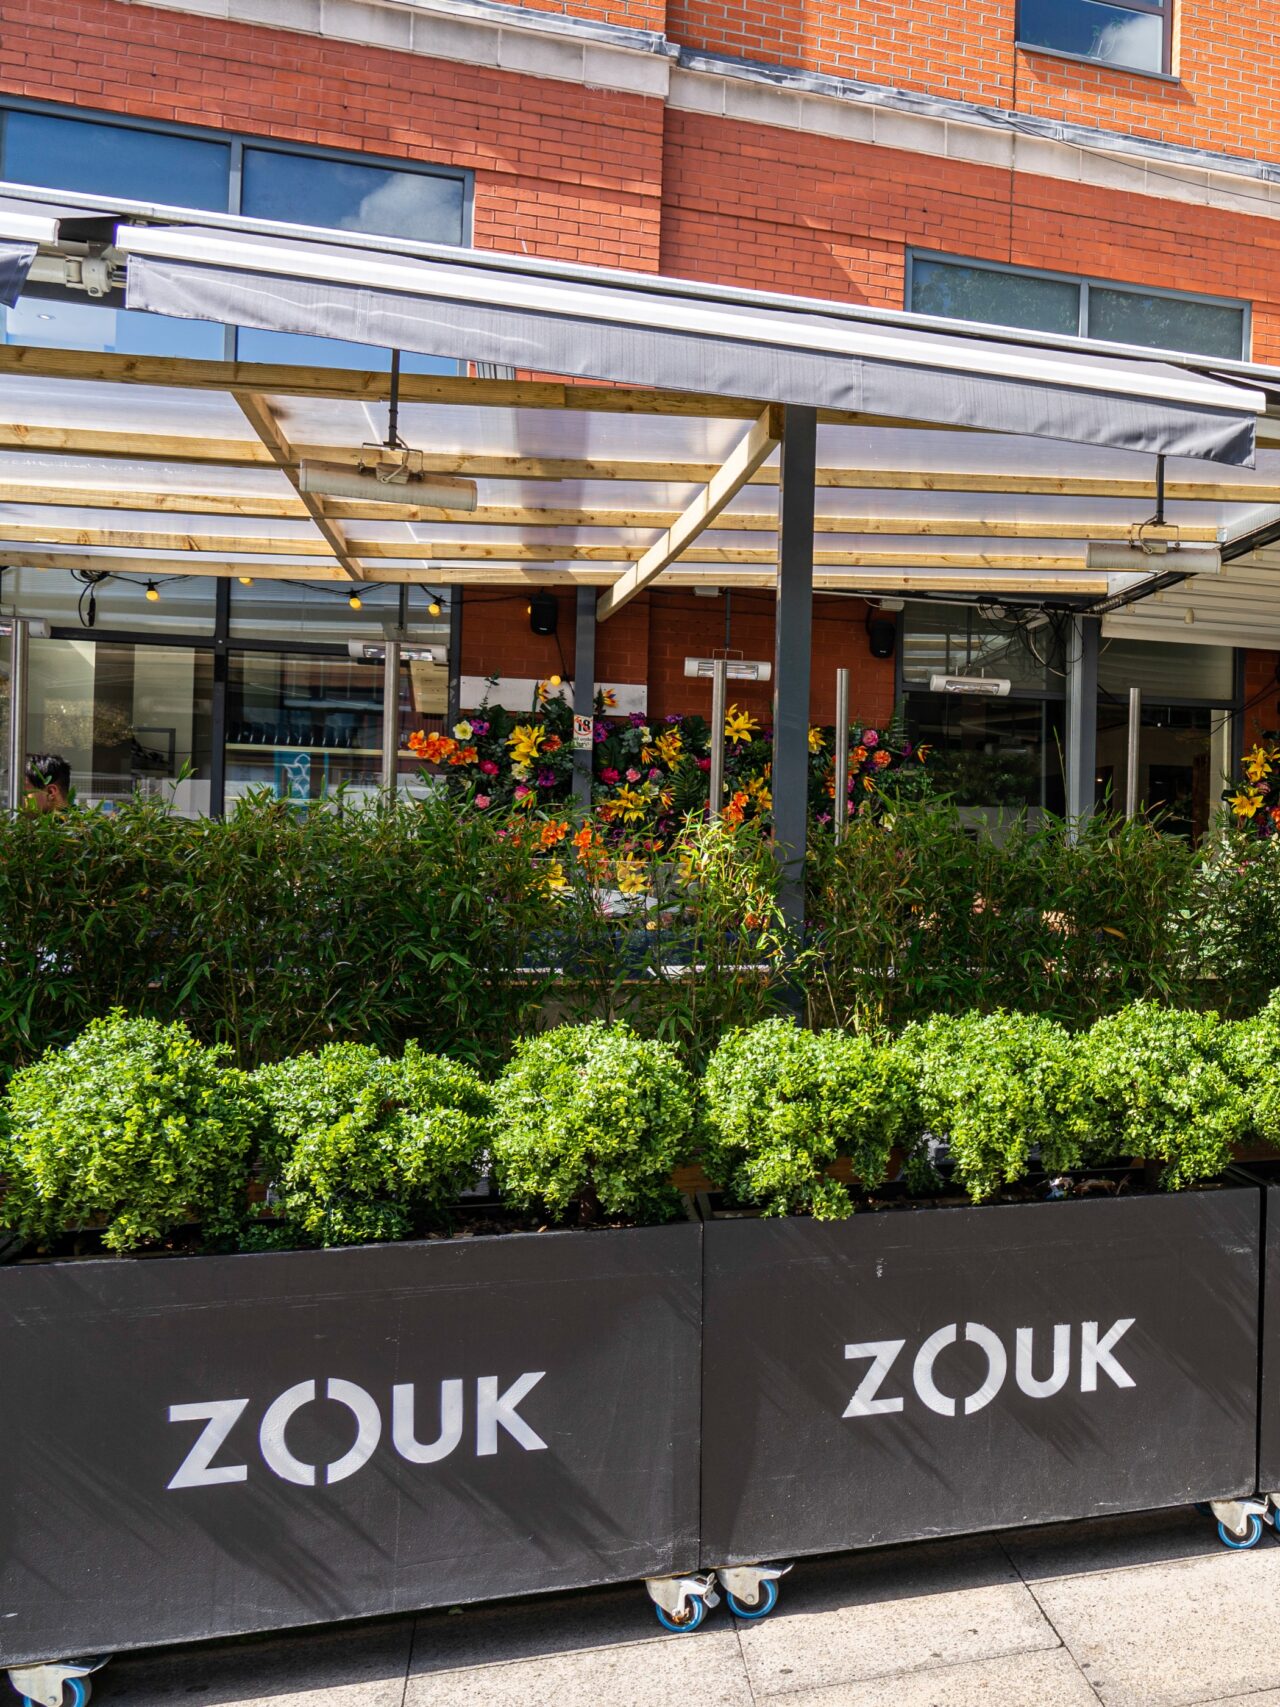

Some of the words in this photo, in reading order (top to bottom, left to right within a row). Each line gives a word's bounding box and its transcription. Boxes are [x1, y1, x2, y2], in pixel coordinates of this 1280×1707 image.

[577, 719, 591, 732] 18
[841, 1318, 1137, 1418] ZOUK
[167, 1371, 549, 1490] ZOUK
